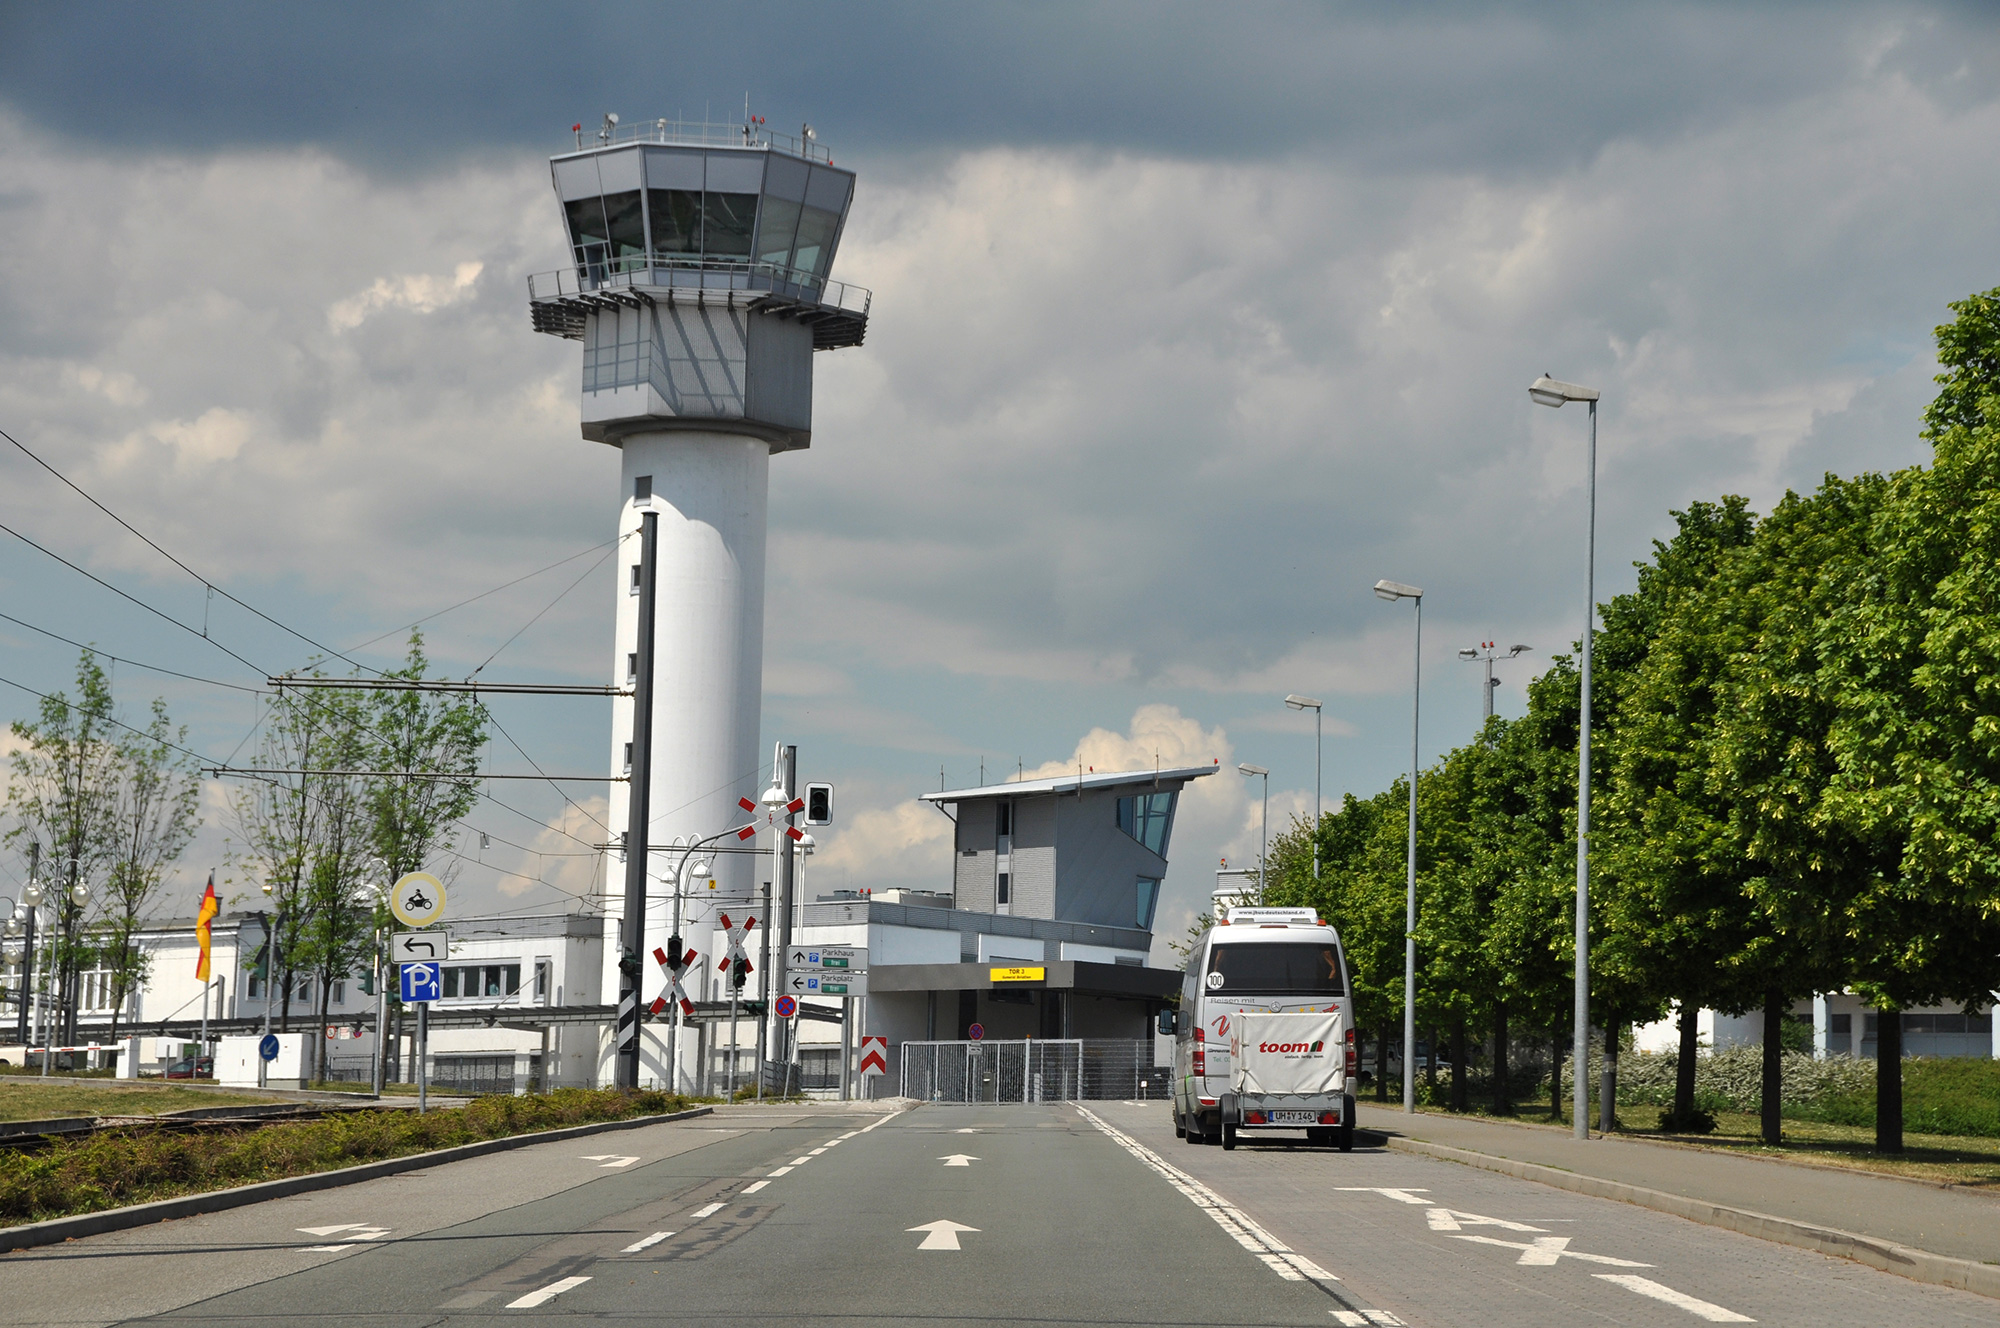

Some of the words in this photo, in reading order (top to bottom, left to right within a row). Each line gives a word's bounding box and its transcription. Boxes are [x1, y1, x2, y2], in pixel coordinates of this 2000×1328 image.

[821, 975, 853, 983] Parkplatz
[1209, 975, 1222, 986] 100
[1259, 1041, 1309, 1053] toom
[1275, 1112, 1286, 1120] UH
[1291, 1112, 1297, 1120] Y
[1298, 1112, 1312, 1120] 146
